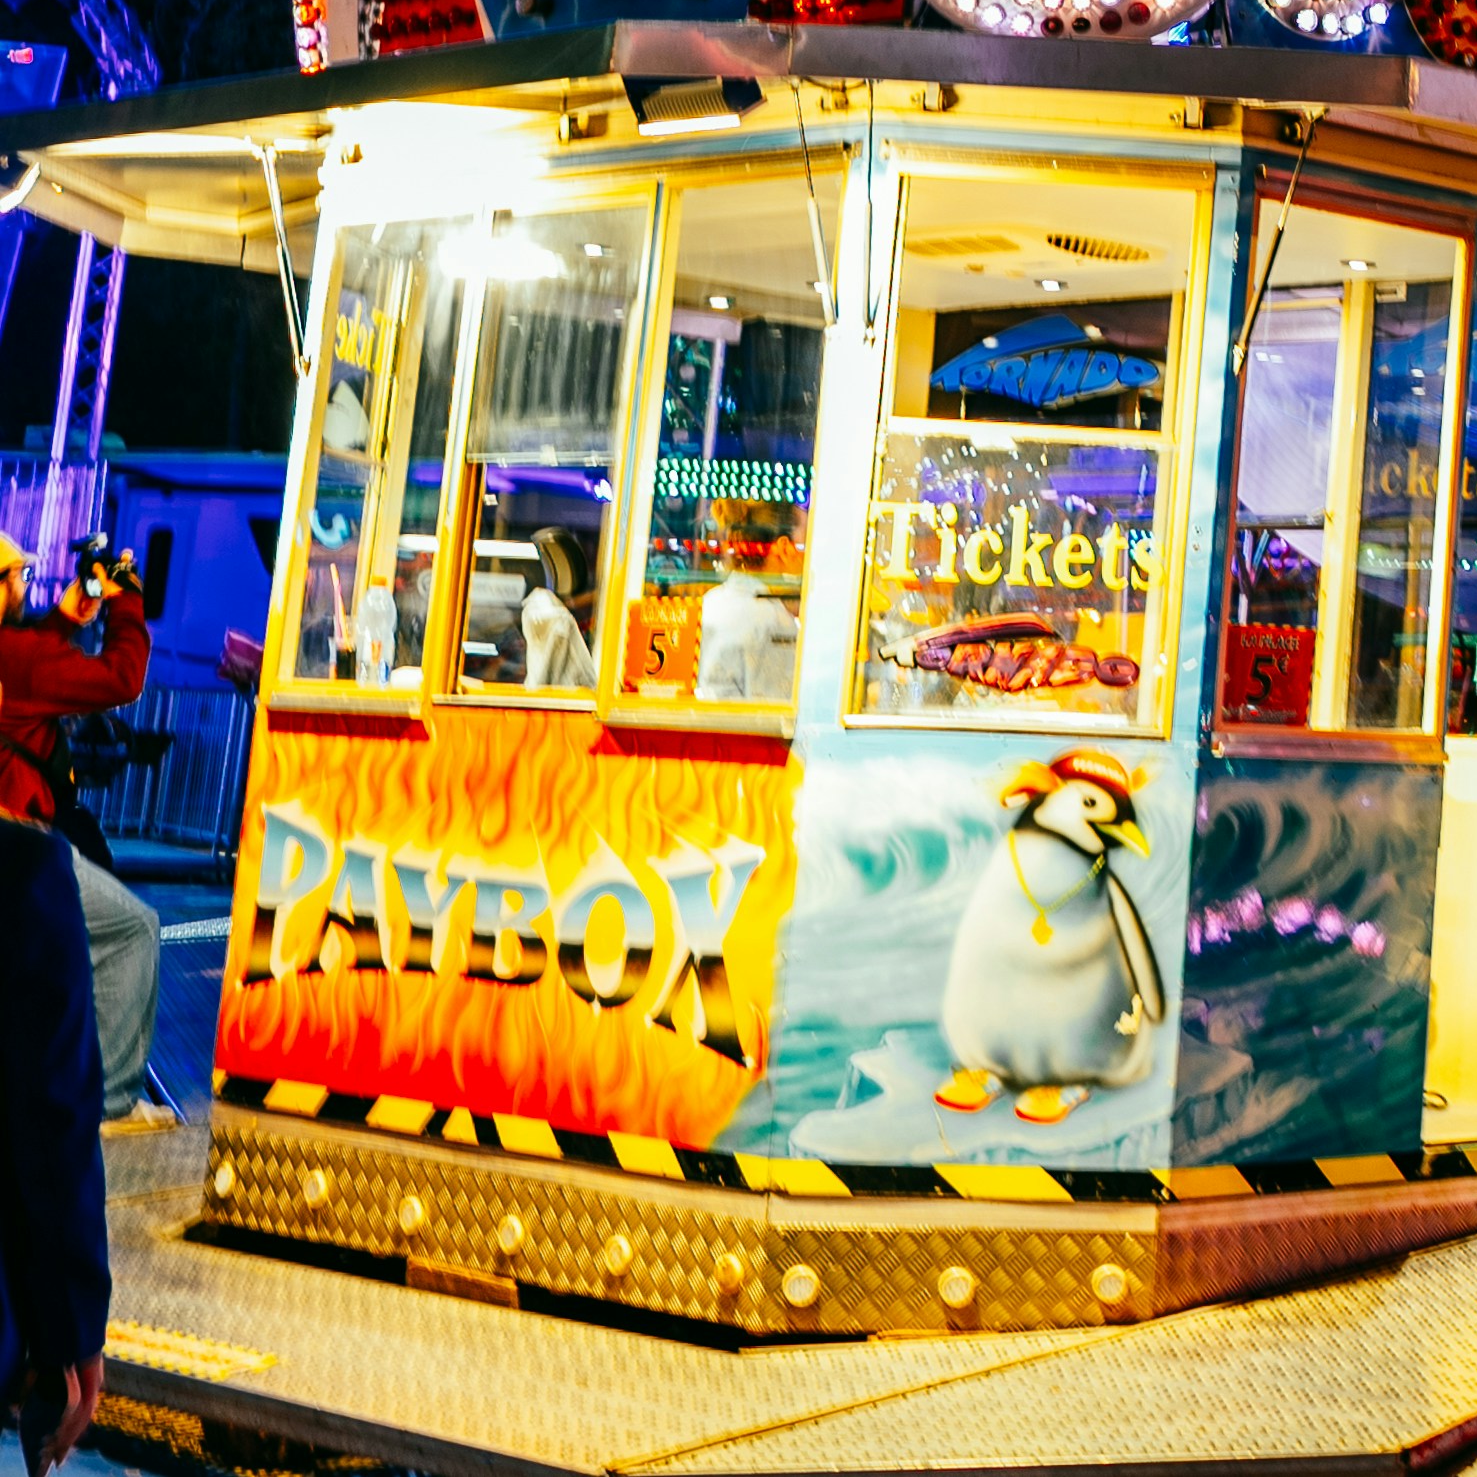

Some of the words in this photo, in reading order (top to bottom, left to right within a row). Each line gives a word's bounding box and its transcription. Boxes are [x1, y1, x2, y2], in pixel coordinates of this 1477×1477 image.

[930, 315, 1161, 408] TORNADO
[869, 501, 1165, 591] Tickets
[237, 800, 767, 1070] PAYBOX
